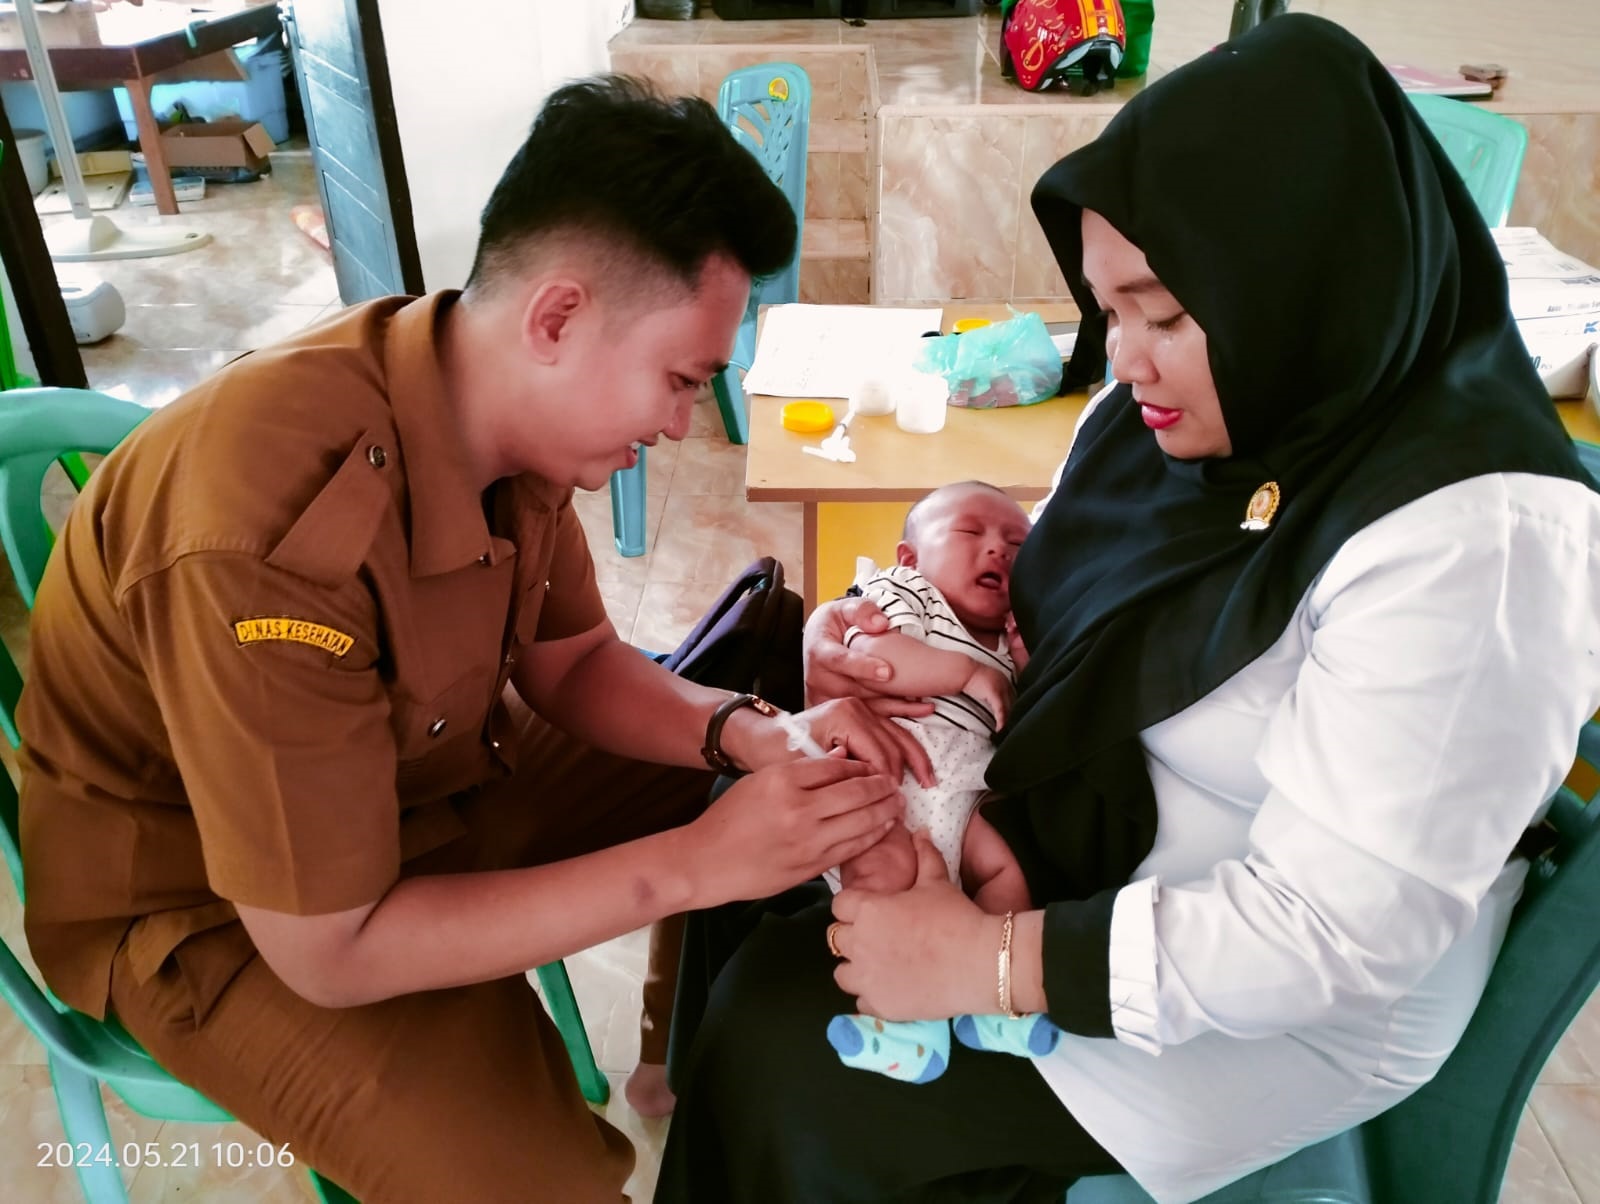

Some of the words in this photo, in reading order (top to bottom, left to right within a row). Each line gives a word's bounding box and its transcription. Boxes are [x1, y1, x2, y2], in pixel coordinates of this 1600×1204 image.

[1584, 320, 1600, 334] K
[239, 621, 283, 640] DINAS
[287, 621, 348, 653] KESEHATAN
